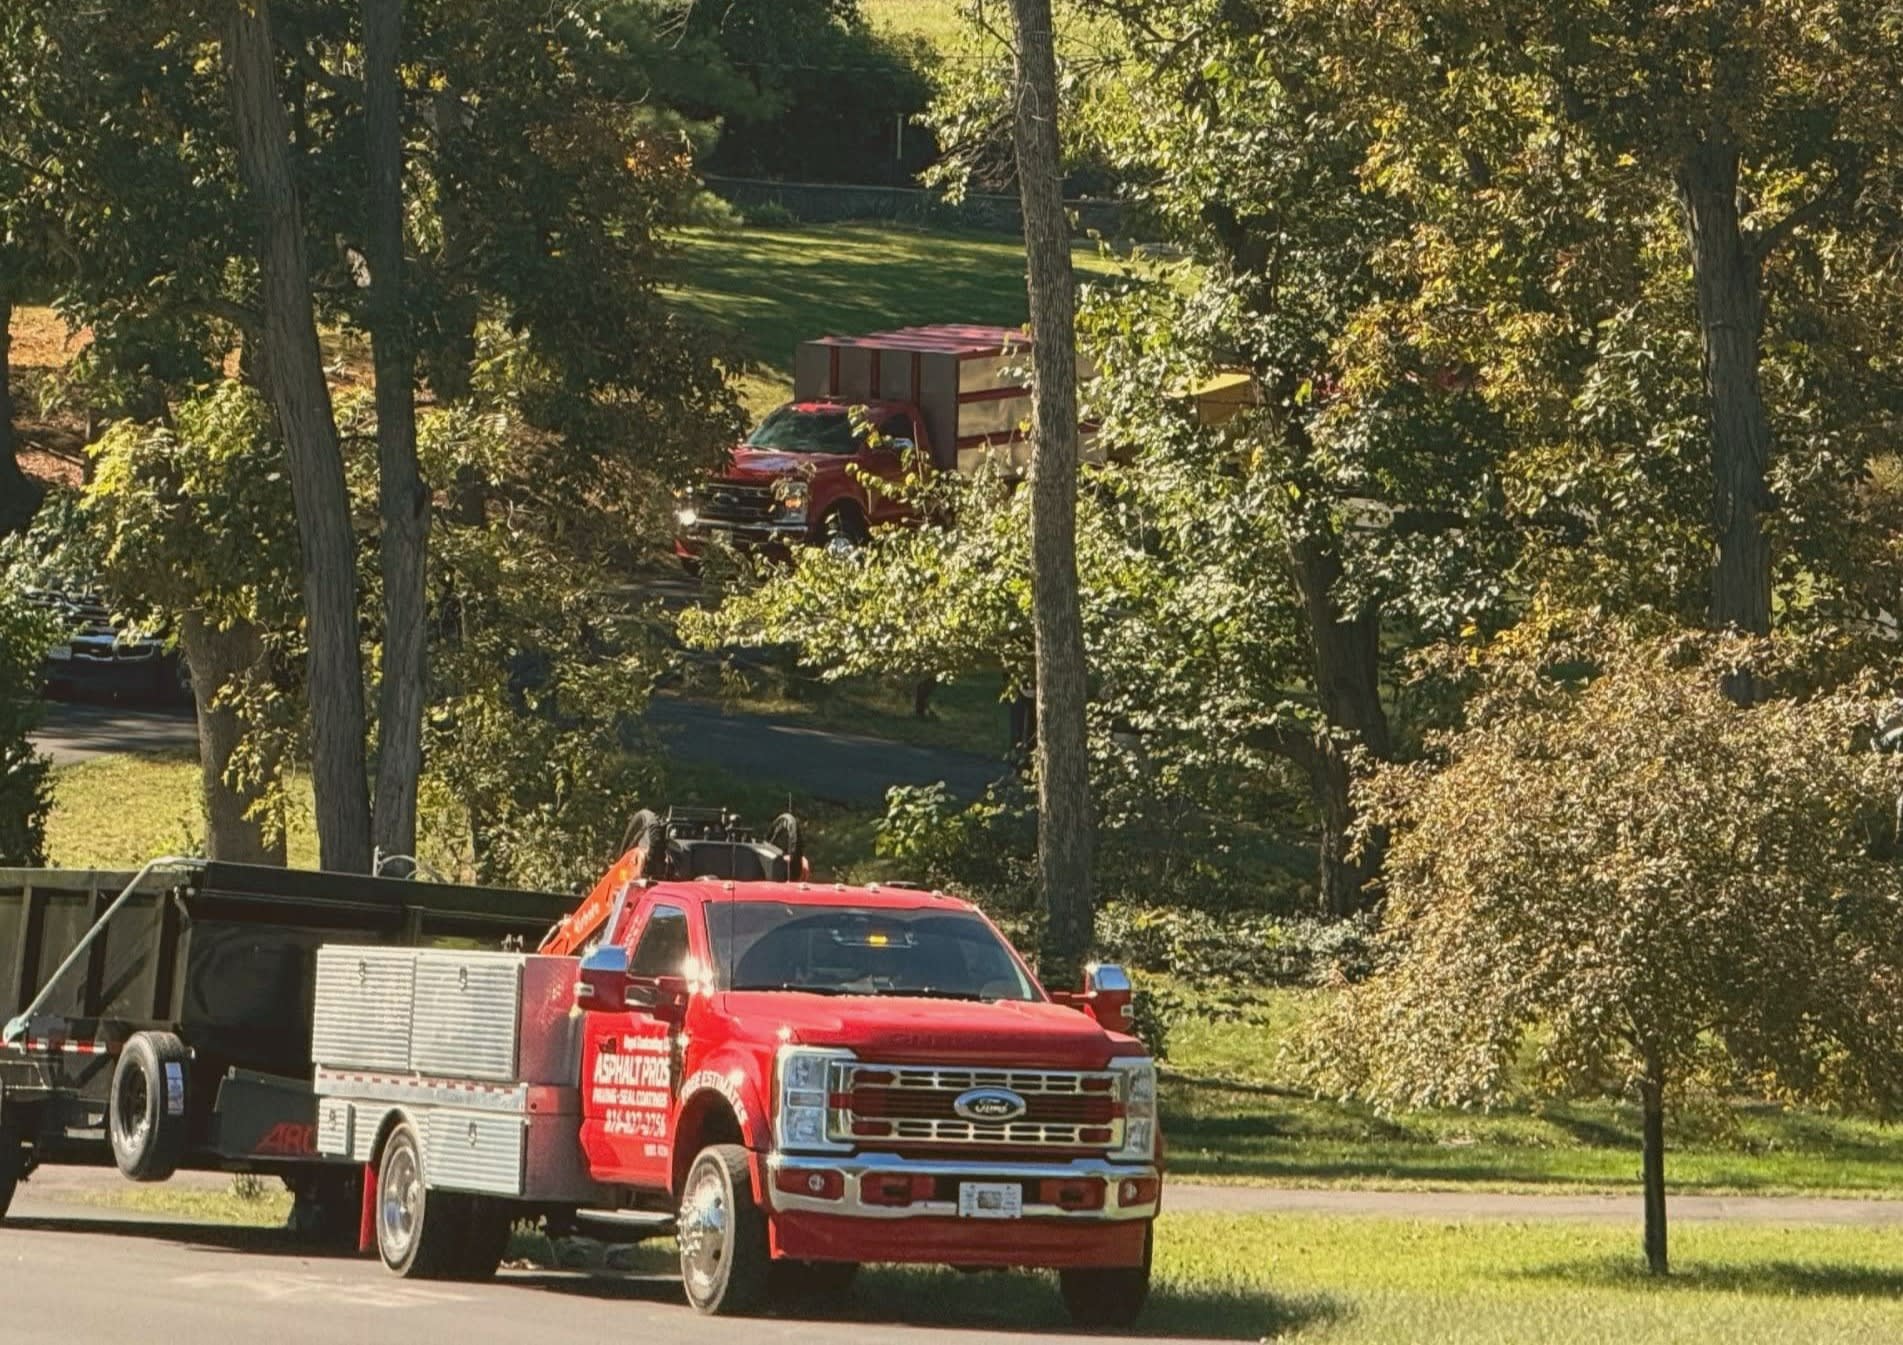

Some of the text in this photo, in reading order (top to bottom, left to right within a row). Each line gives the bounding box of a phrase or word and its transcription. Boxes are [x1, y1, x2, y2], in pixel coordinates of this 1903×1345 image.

[593, 1052, 671, 1088] ASPHALT PROS
[701, 1068, 749, 1126] ESTIMATES
[975, 1098, 1009, 1114] Ford
